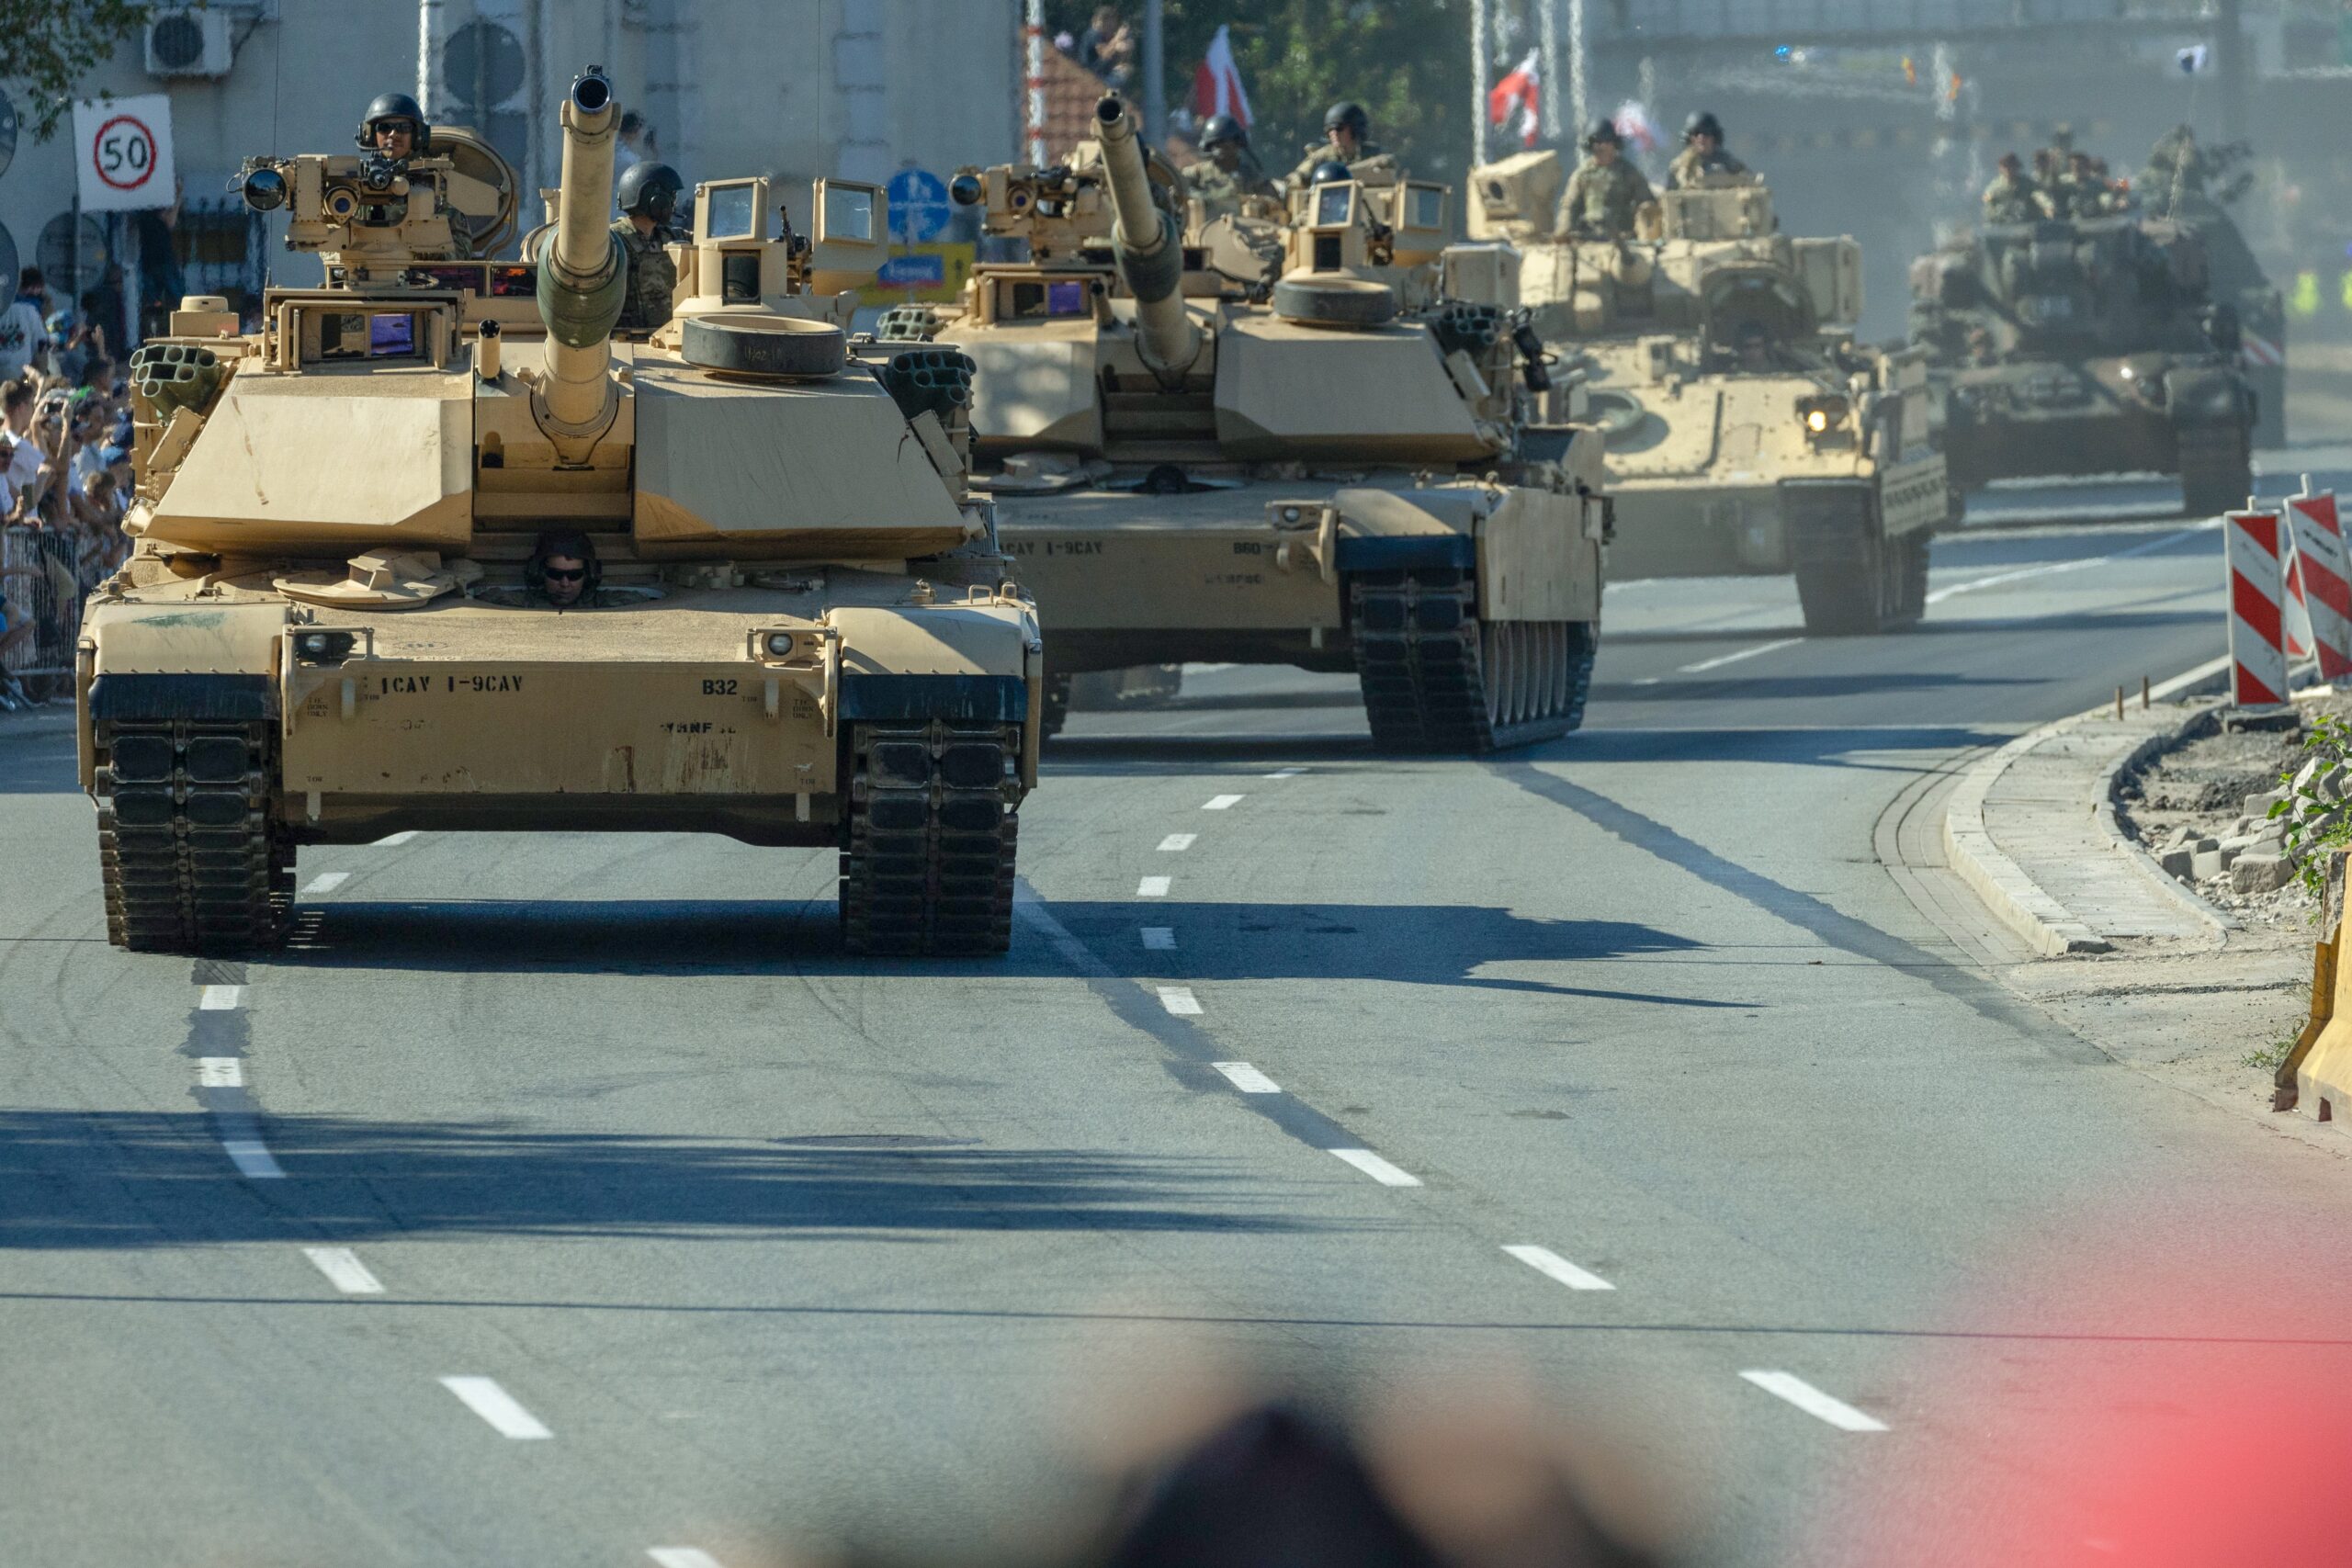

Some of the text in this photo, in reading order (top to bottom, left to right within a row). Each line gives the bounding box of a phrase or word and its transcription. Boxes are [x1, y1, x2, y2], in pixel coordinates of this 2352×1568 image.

[104, 135, 147, 171] 50
[381, 675, 523, 694] 1CAV 1-9CAV
[702, 679, 738, 695] B32
